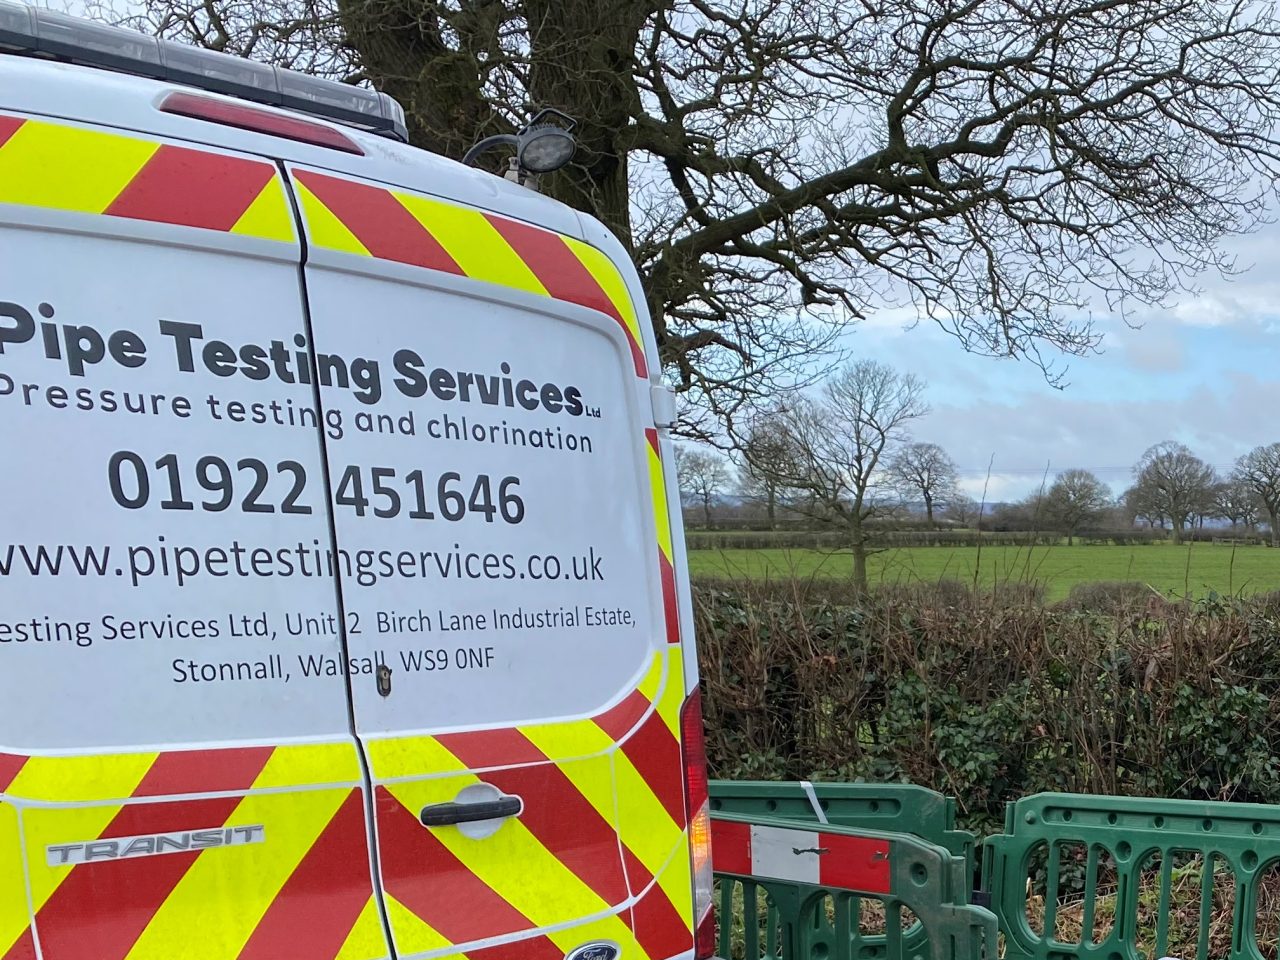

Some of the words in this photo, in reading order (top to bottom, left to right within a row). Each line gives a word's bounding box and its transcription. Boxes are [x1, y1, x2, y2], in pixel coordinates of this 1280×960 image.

[0, 301, 147, 377] Pipe
[159, 319, 382, 405] Testing
[393, 349, 583, 416] Services
[585, 405, 602, 419] Ltd
[207, 394, 344, 440] testing
[355, 410, 416, 436] and
[427, 413, 592, 453] chlorination
[108, 450, 312, 515] 01922
[335, 464, 526, 525] 451646
[102, 613, 220, 640] Services
[229, 611, 277, 640] Ltd,
[286, 610, 337, 636] Unit
[347, 611, 363, 634] 2
[376, 609, 432, 634] Birch
[440, 610, 486, 632] Lane
[494, 605, 580, 630] Industrial
[586, 606, 636, 627] Estate,
[172, 653, 291, 683] Stonnall,
[400, 648, 449, 673] WS9
[455, 647, 495, 669] 0NF
[47, 824, 265, 863] TRANSIT
